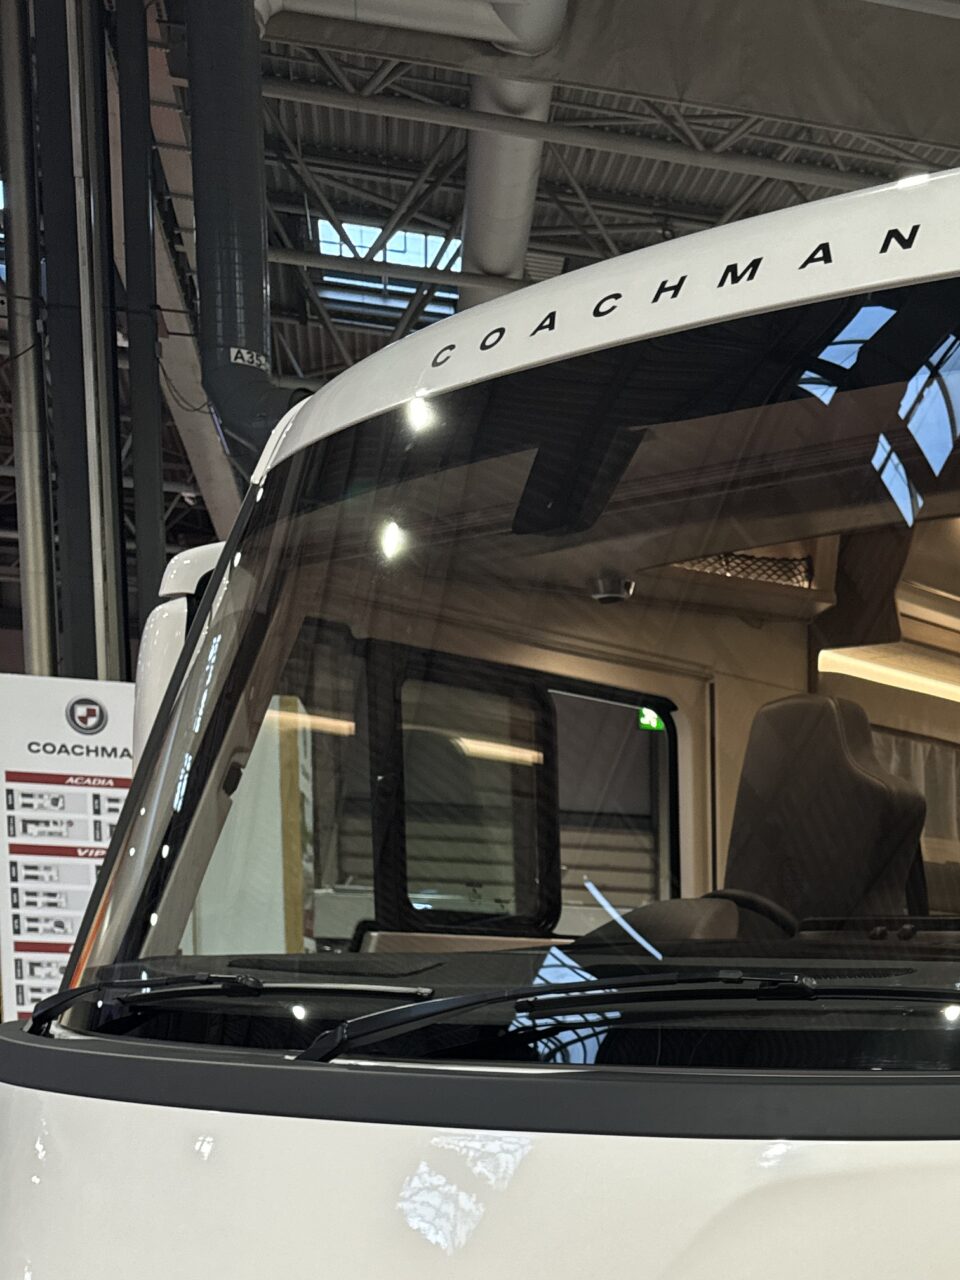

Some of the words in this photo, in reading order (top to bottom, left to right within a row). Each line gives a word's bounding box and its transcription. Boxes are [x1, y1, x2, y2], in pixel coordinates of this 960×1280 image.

[432, 224, 921, 368] COACHMAN
[27, 741, 133, 759] COACHMA
[64, 776, 115, 787] ACADIA
